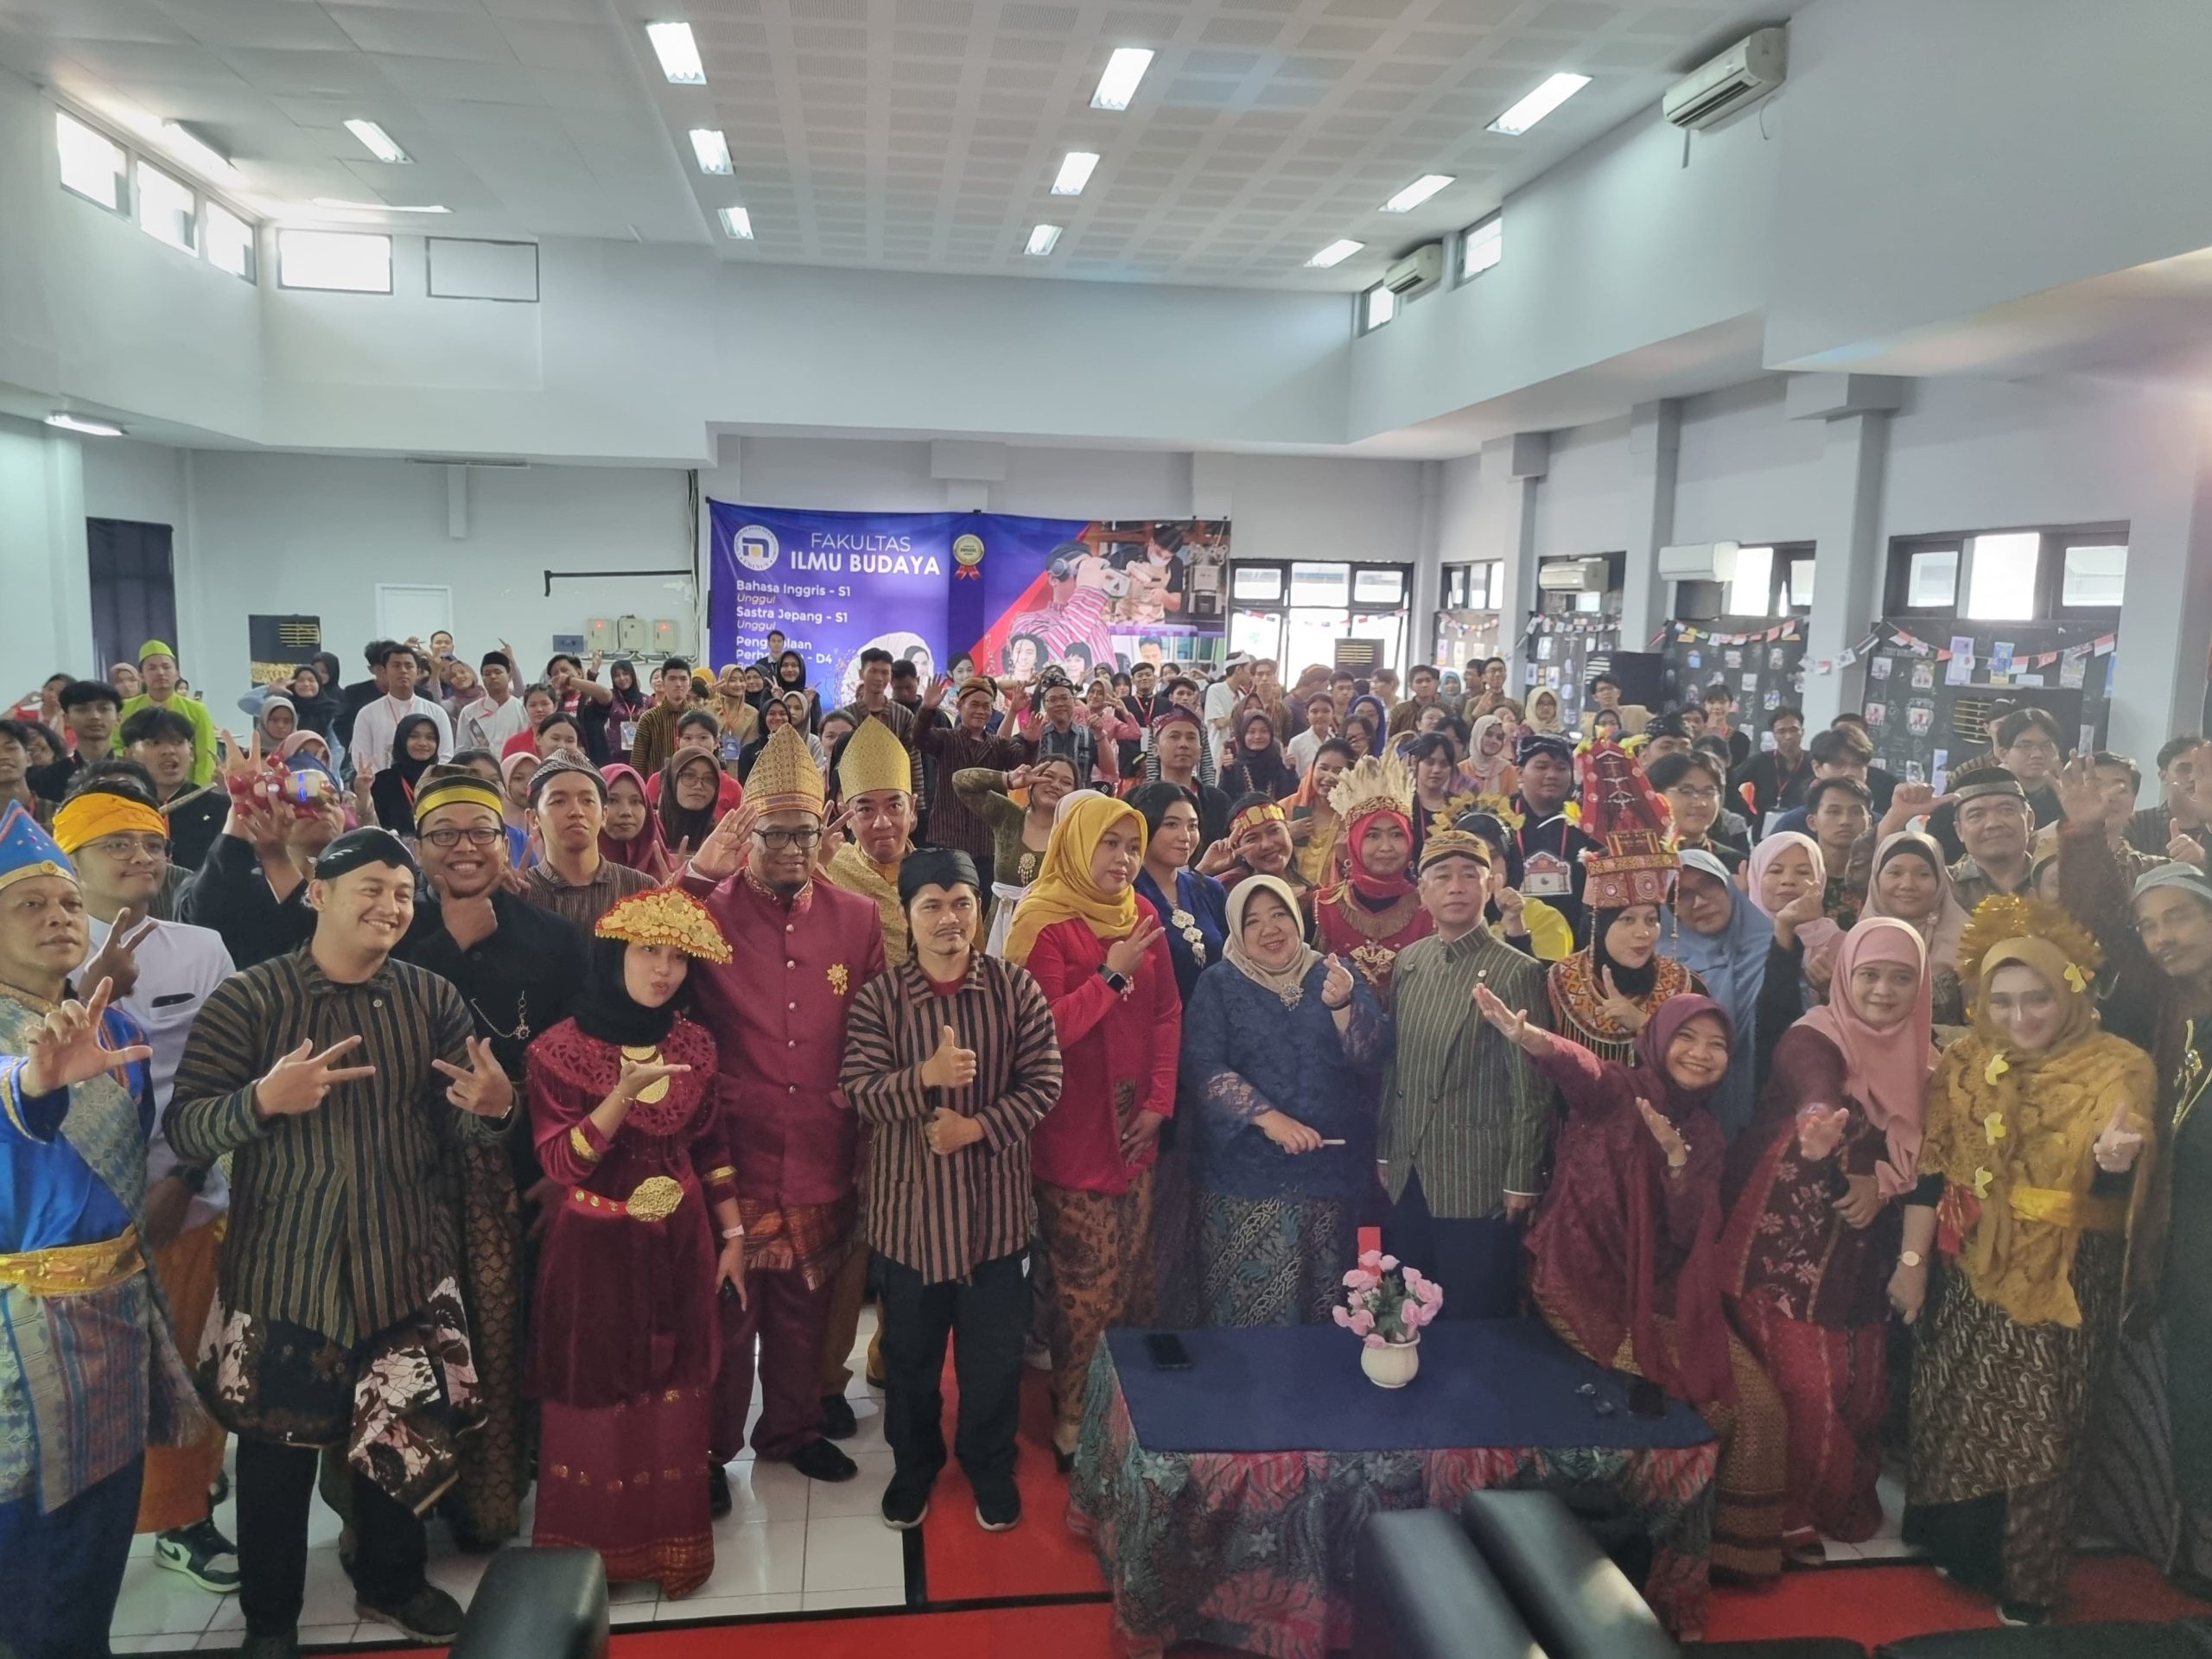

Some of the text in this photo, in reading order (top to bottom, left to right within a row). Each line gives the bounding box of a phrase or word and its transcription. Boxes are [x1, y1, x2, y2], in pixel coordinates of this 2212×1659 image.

[811, 533, 911, 552] FAKULTAS
[791, 551, 941, 575] ILMU BUDAYA
[736, 580, 779, 594] Bahasa
[784, 583, 826, 597] Inggris
[838, 586, 851, 597] S1
[737, 594, 776, 605] Unggul
[736, 607, 774, 619] Sastra
[778, 608, 823, 624] Jepang
[835, 612, 849, 623] S1
[737, 620, 776, 632] Unggul
[816, 653, 832, 664] D4
